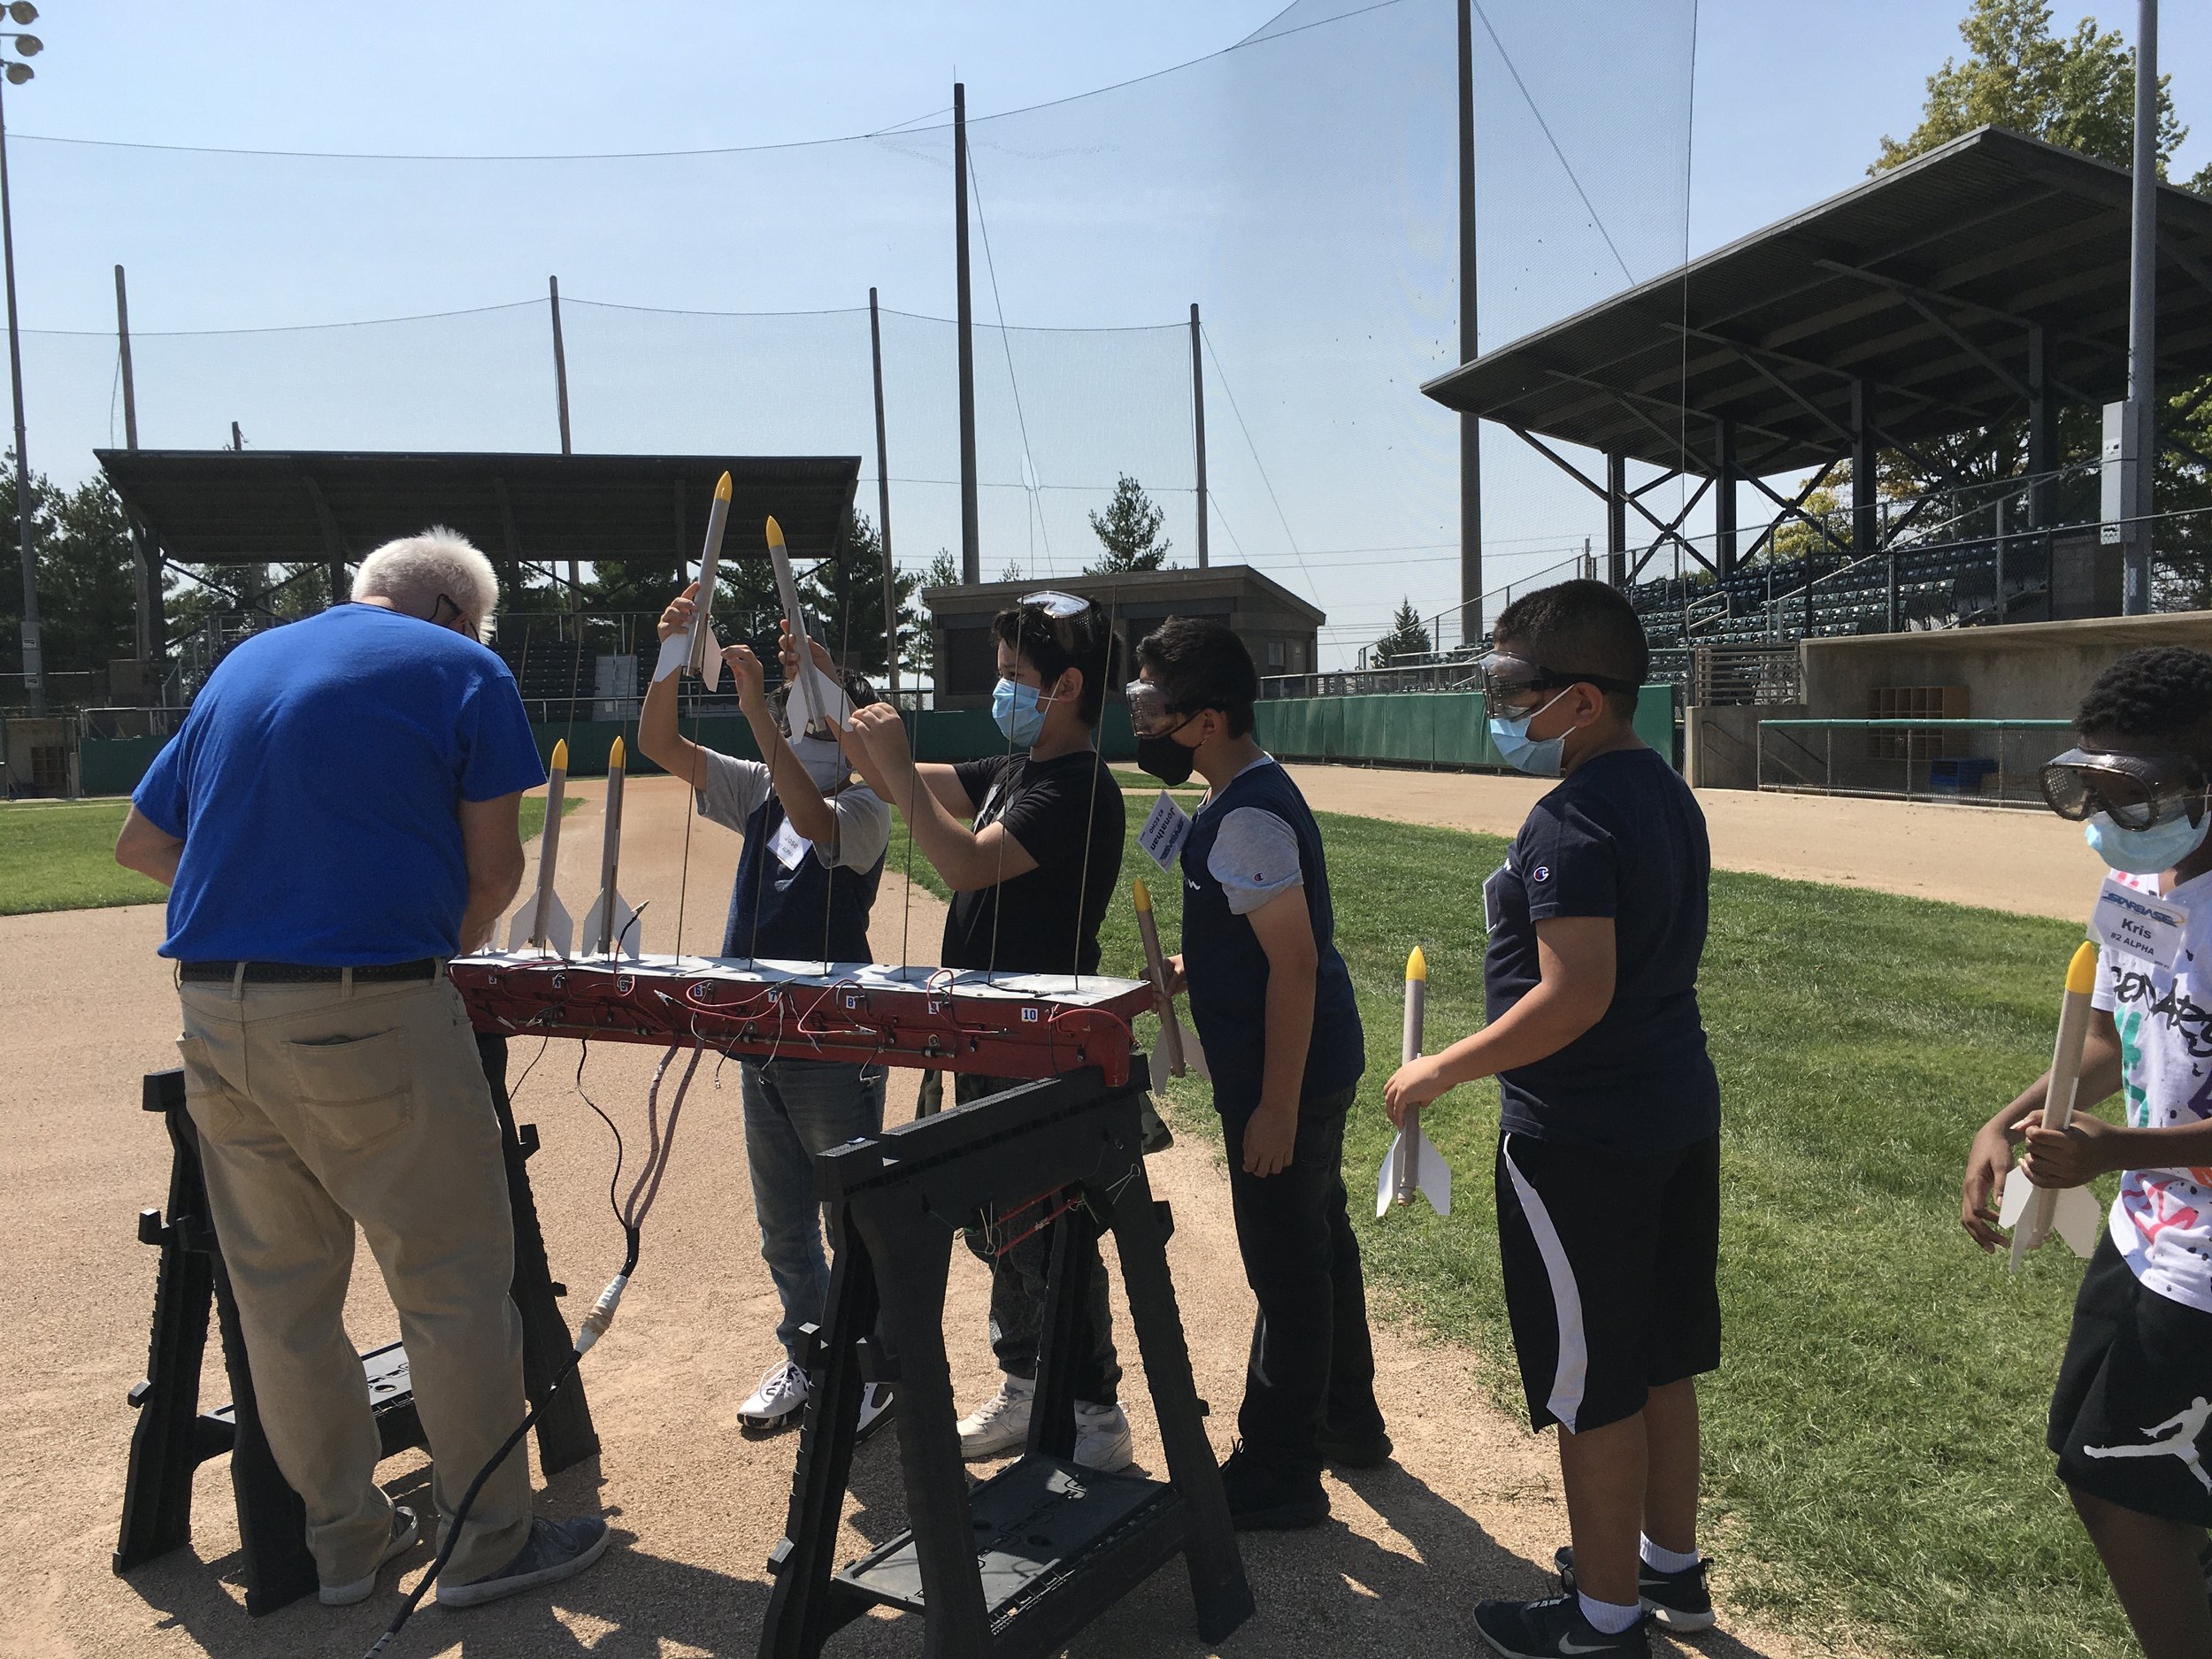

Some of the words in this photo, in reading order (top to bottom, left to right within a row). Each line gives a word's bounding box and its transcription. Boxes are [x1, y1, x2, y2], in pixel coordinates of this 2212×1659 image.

[1149, 817, 1160, 833] ECHO
[1150, 807, 1175, 850] Jonathan
[784, 835, 799, 849] Jose
[2101, 892, 2178, 928] STARBASE
[2121, 918, 2152, 940] Kris
[2110, 932, 2122, 941] #2
[2124, 937, 2154, 956] ALPHA
[695, 986, 701, 995] 6
[770, 991, 776, 1001] 7
[848, 997, 854, 1007] 8
[1024, 1010, 1036, 1019] 10
